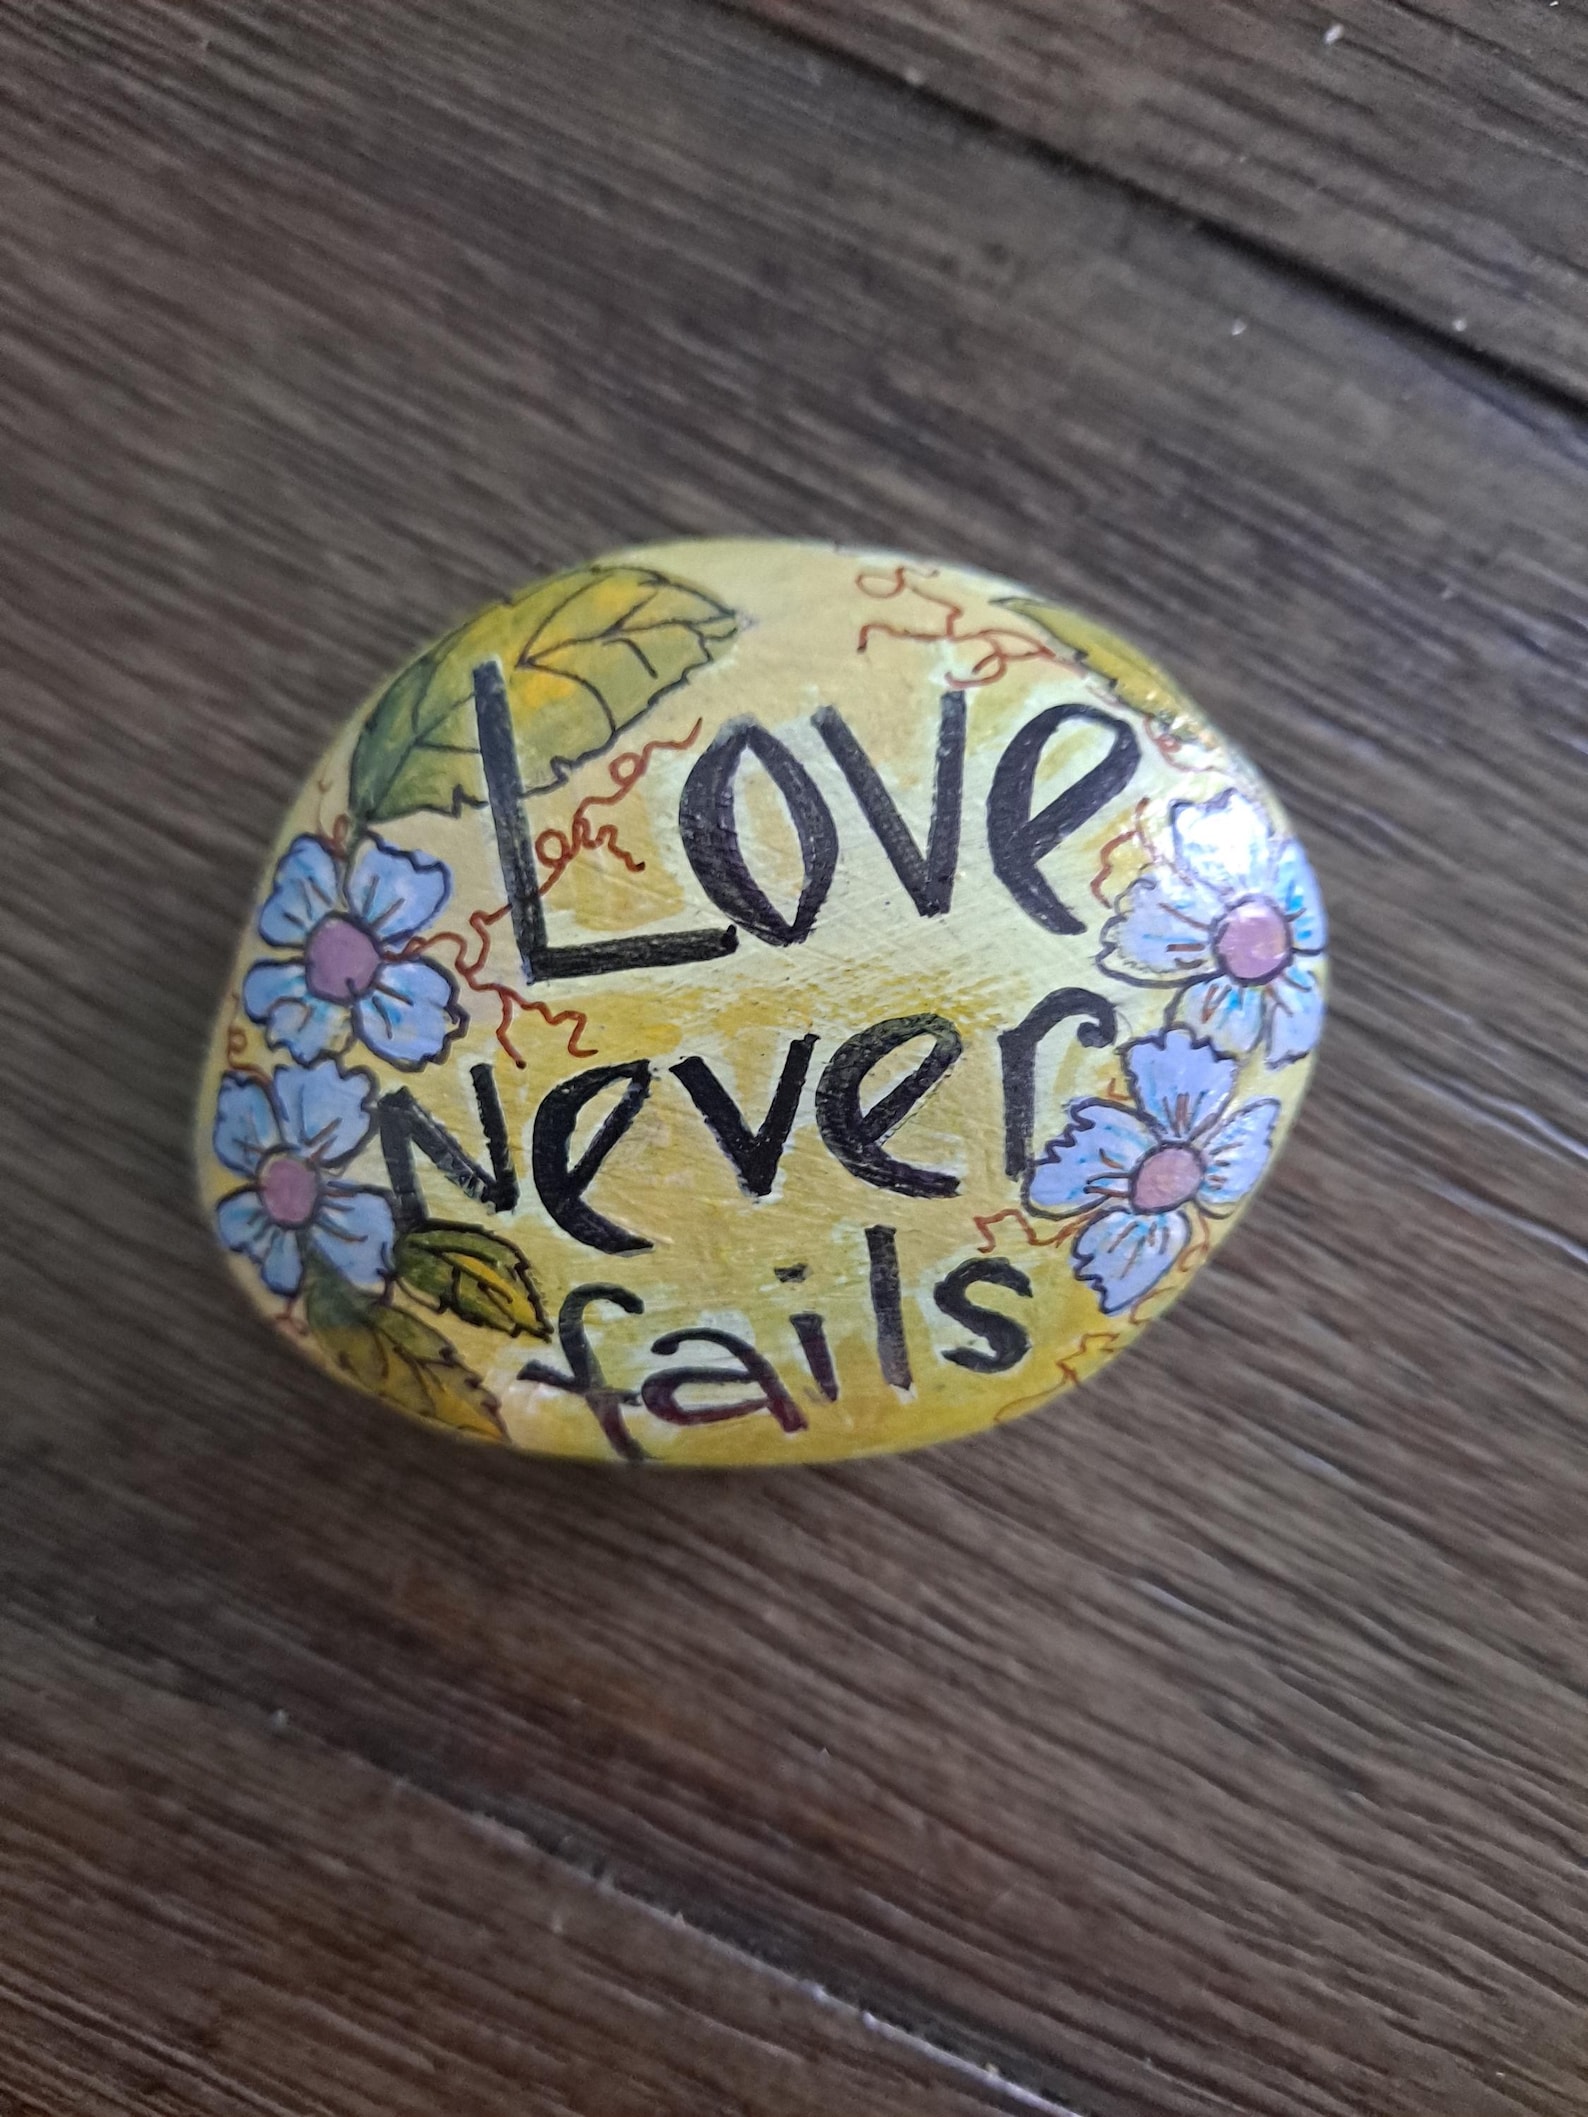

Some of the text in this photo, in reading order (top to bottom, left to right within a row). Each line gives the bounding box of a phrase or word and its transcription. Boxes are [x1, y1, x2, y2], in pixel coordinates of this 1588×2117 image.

[473, 660, 1142, 983] Love
[378, 987, 1117, 1255] Never
[517, 1224, 1034, 1460] fails
